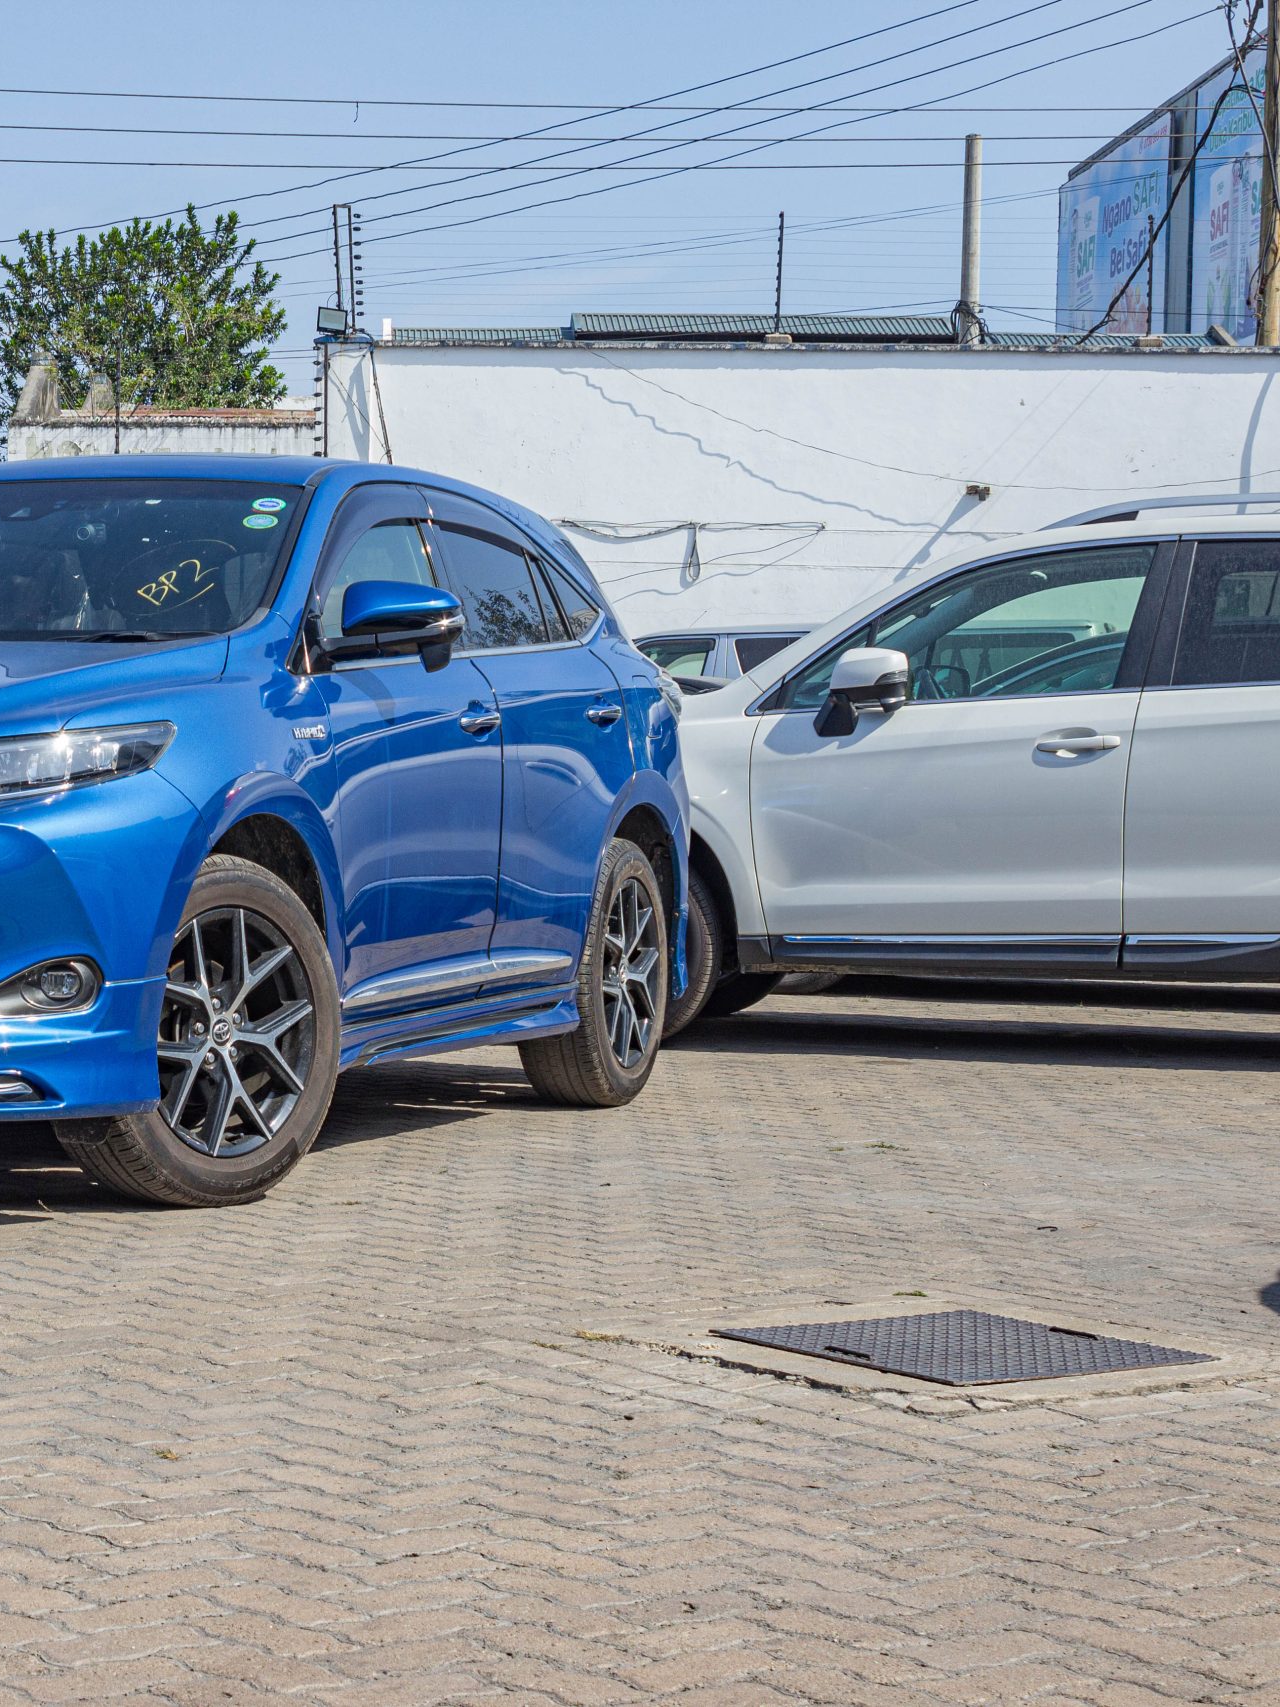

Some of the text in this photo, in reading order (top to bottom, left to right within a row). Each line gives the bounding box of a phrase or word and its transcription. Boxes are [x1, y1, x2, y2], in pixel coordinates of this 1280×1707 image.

[1102, 196, 1132, 238] Ngano
[1210, 200, 1230, 242] SAFI
[1077, 235, 1096, 278] SAFI
[1109, 239, 1126, 278] Bei
[1126, 227, 1147, 270] Safi
